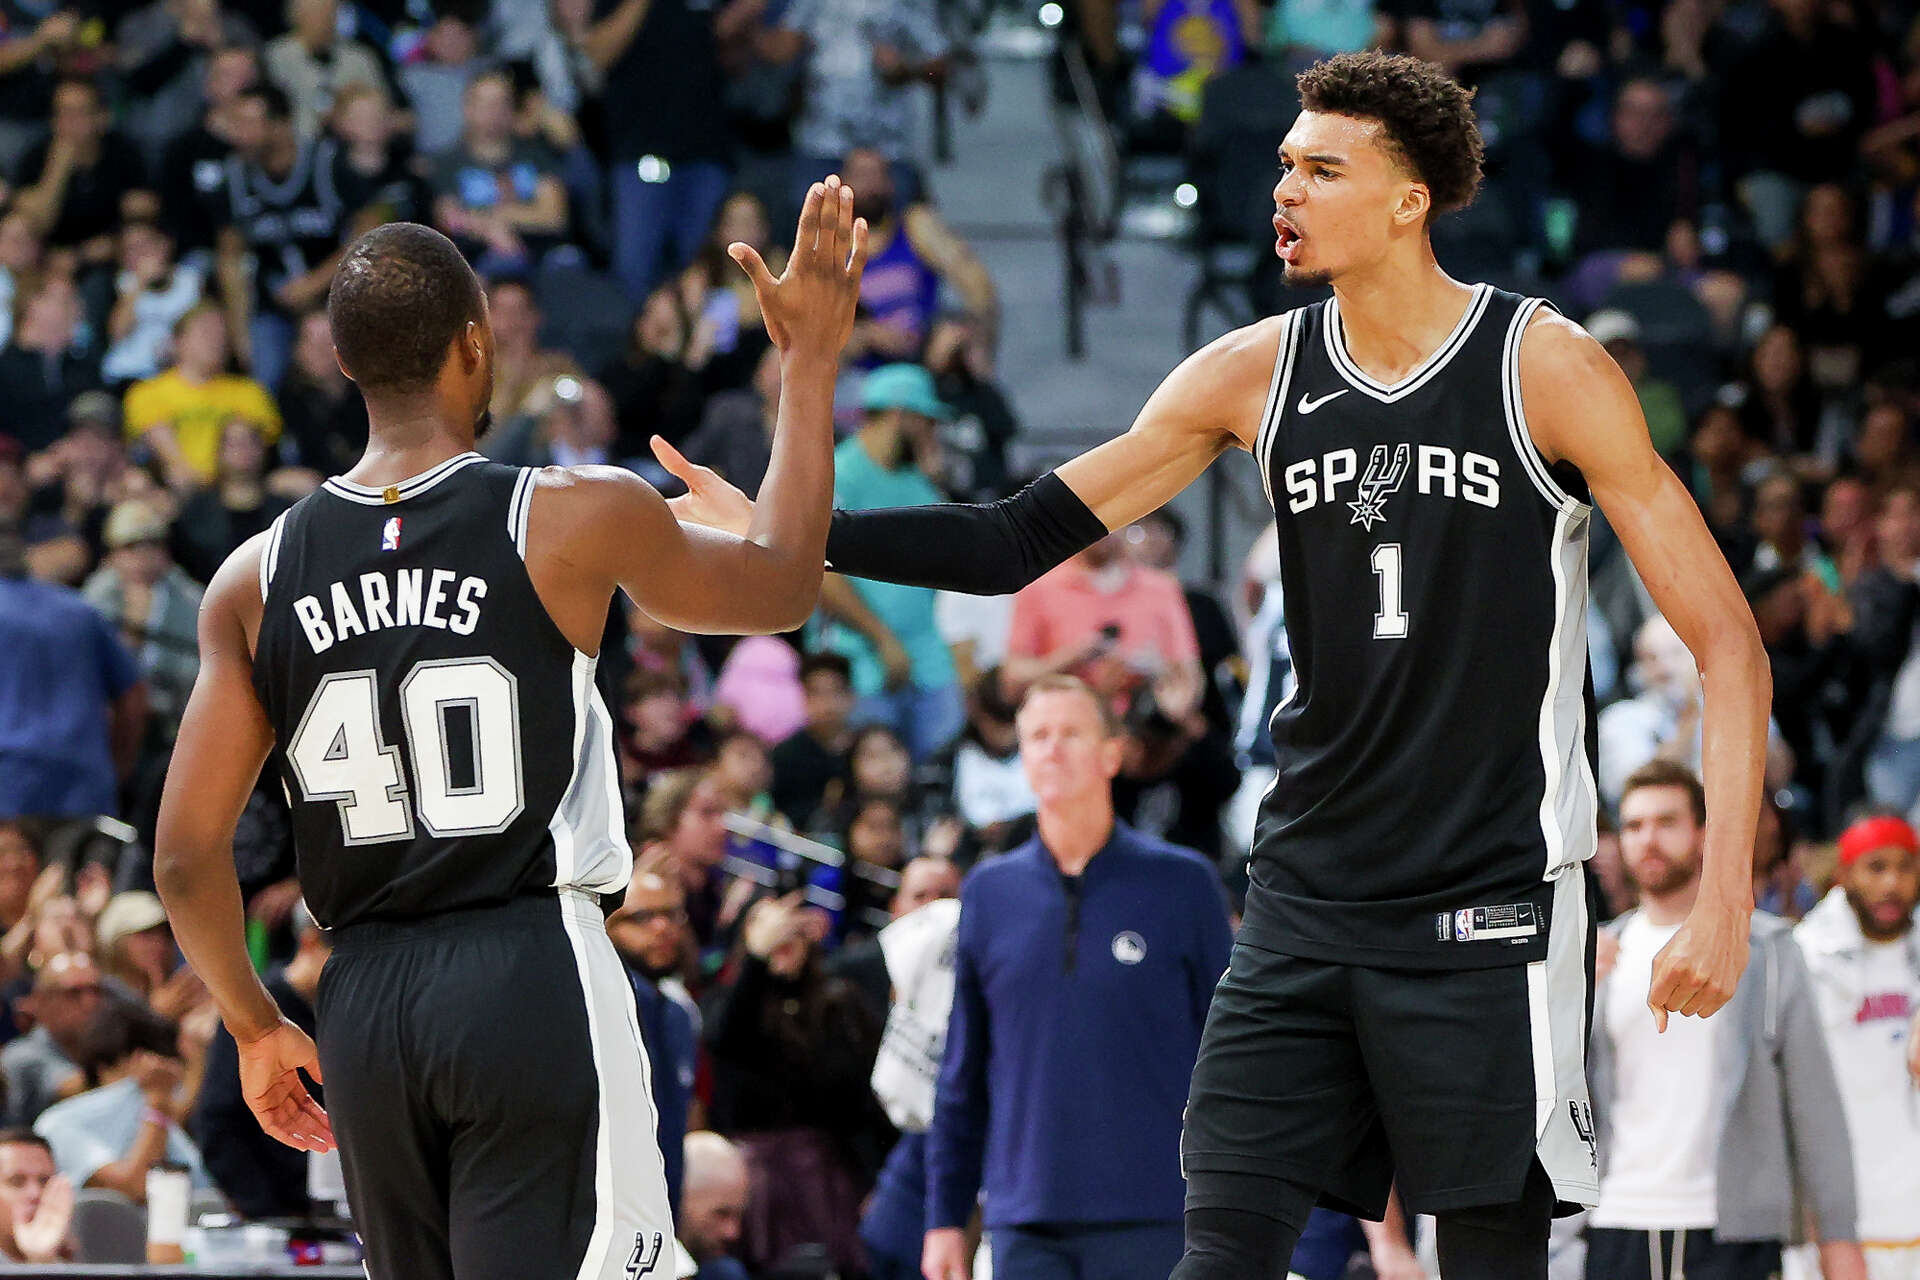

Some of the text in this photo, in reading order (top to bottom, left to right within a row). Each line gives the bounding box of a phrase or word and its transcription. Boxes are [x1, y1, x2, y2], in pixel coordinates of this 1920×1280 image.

[1285, 443, 1499, 532] SPURS
[293, 569, 487, 654] BARNES
[1371, 543, 1409, 639] 1
[286, 655, 525, 847] 40
